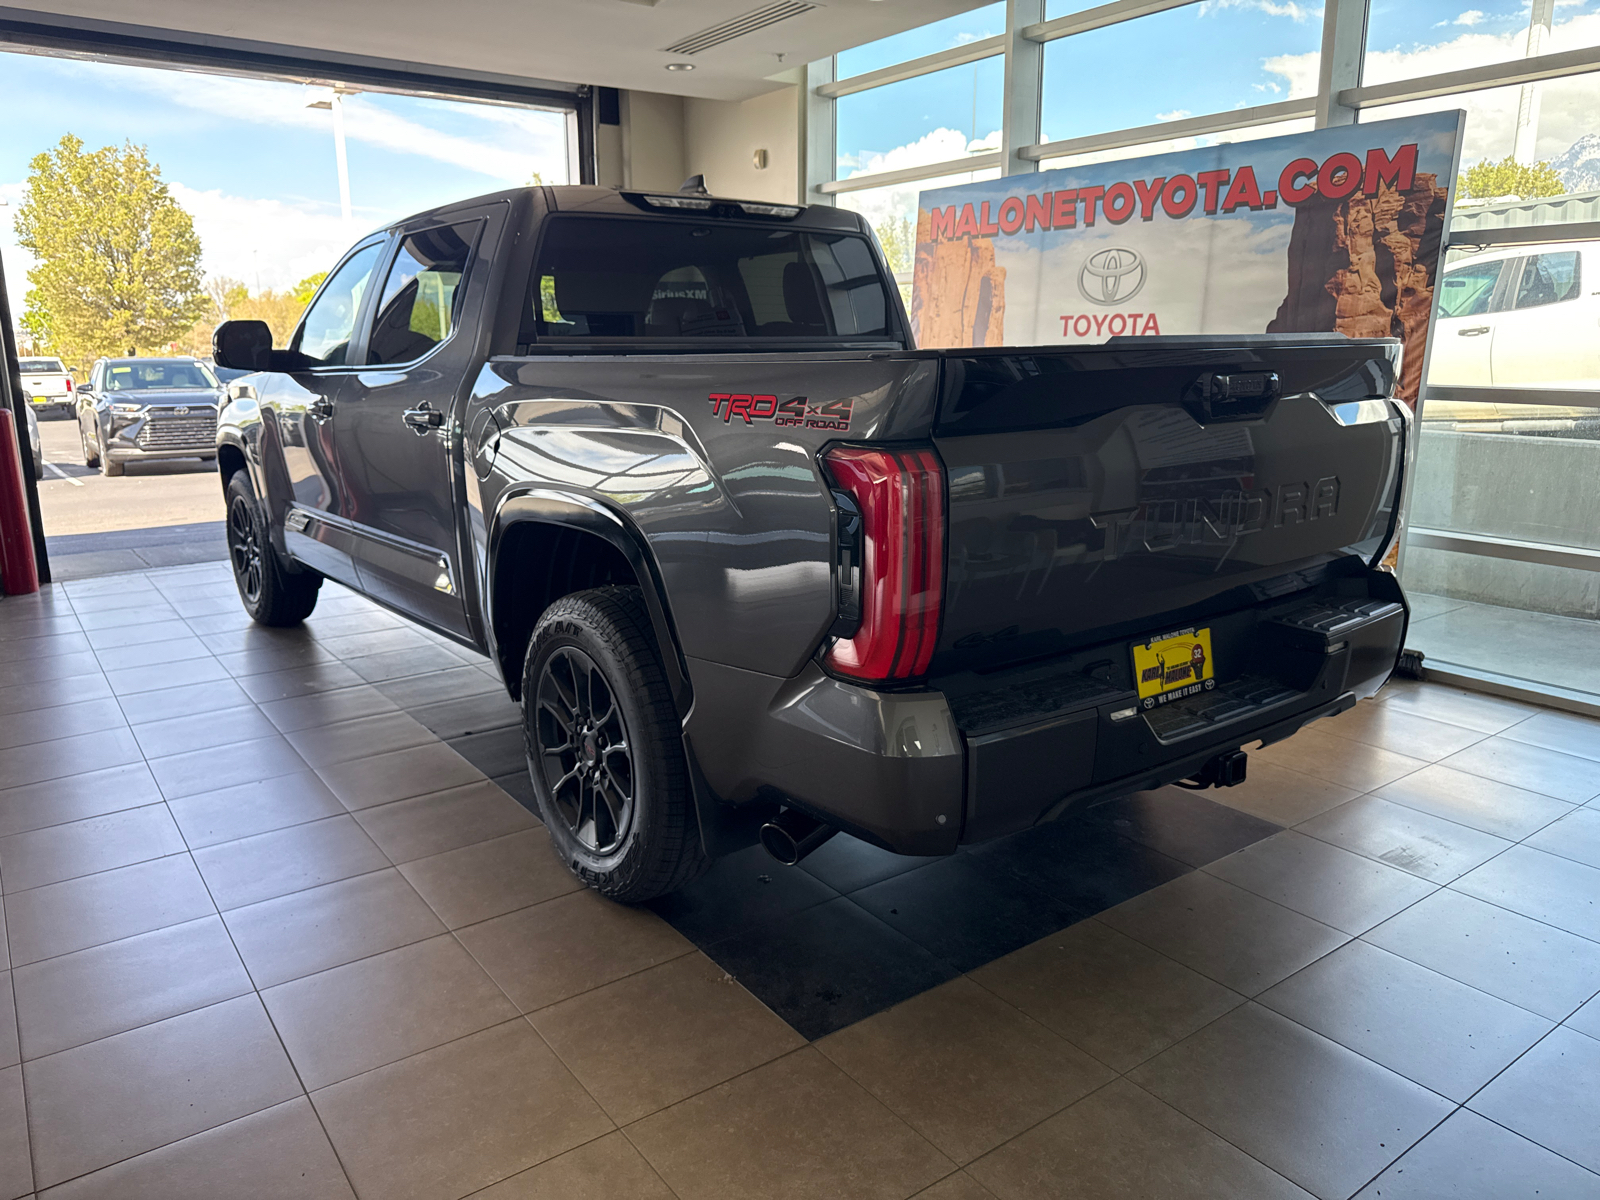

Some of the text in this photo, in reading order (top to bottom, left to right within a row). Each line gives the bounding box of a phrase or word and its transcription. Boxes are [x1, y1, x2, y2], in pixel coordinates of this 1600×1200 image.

[930, 143, 1418, 241] MALONETOYOTA.COM
[1060, 313, 1160, 337] TOYOTA
[708, 393, 854, 427] TRD 4x4
[775, 417, 850, 432] OFF ROAD
[1089, 475, 1341, 560] TUNDRA
[1194, 649, 1202, 658] 32
[1142, 666, 1160, 683] KARL
[1158, 684, 1202, 704] WE MAKE IT EASY
